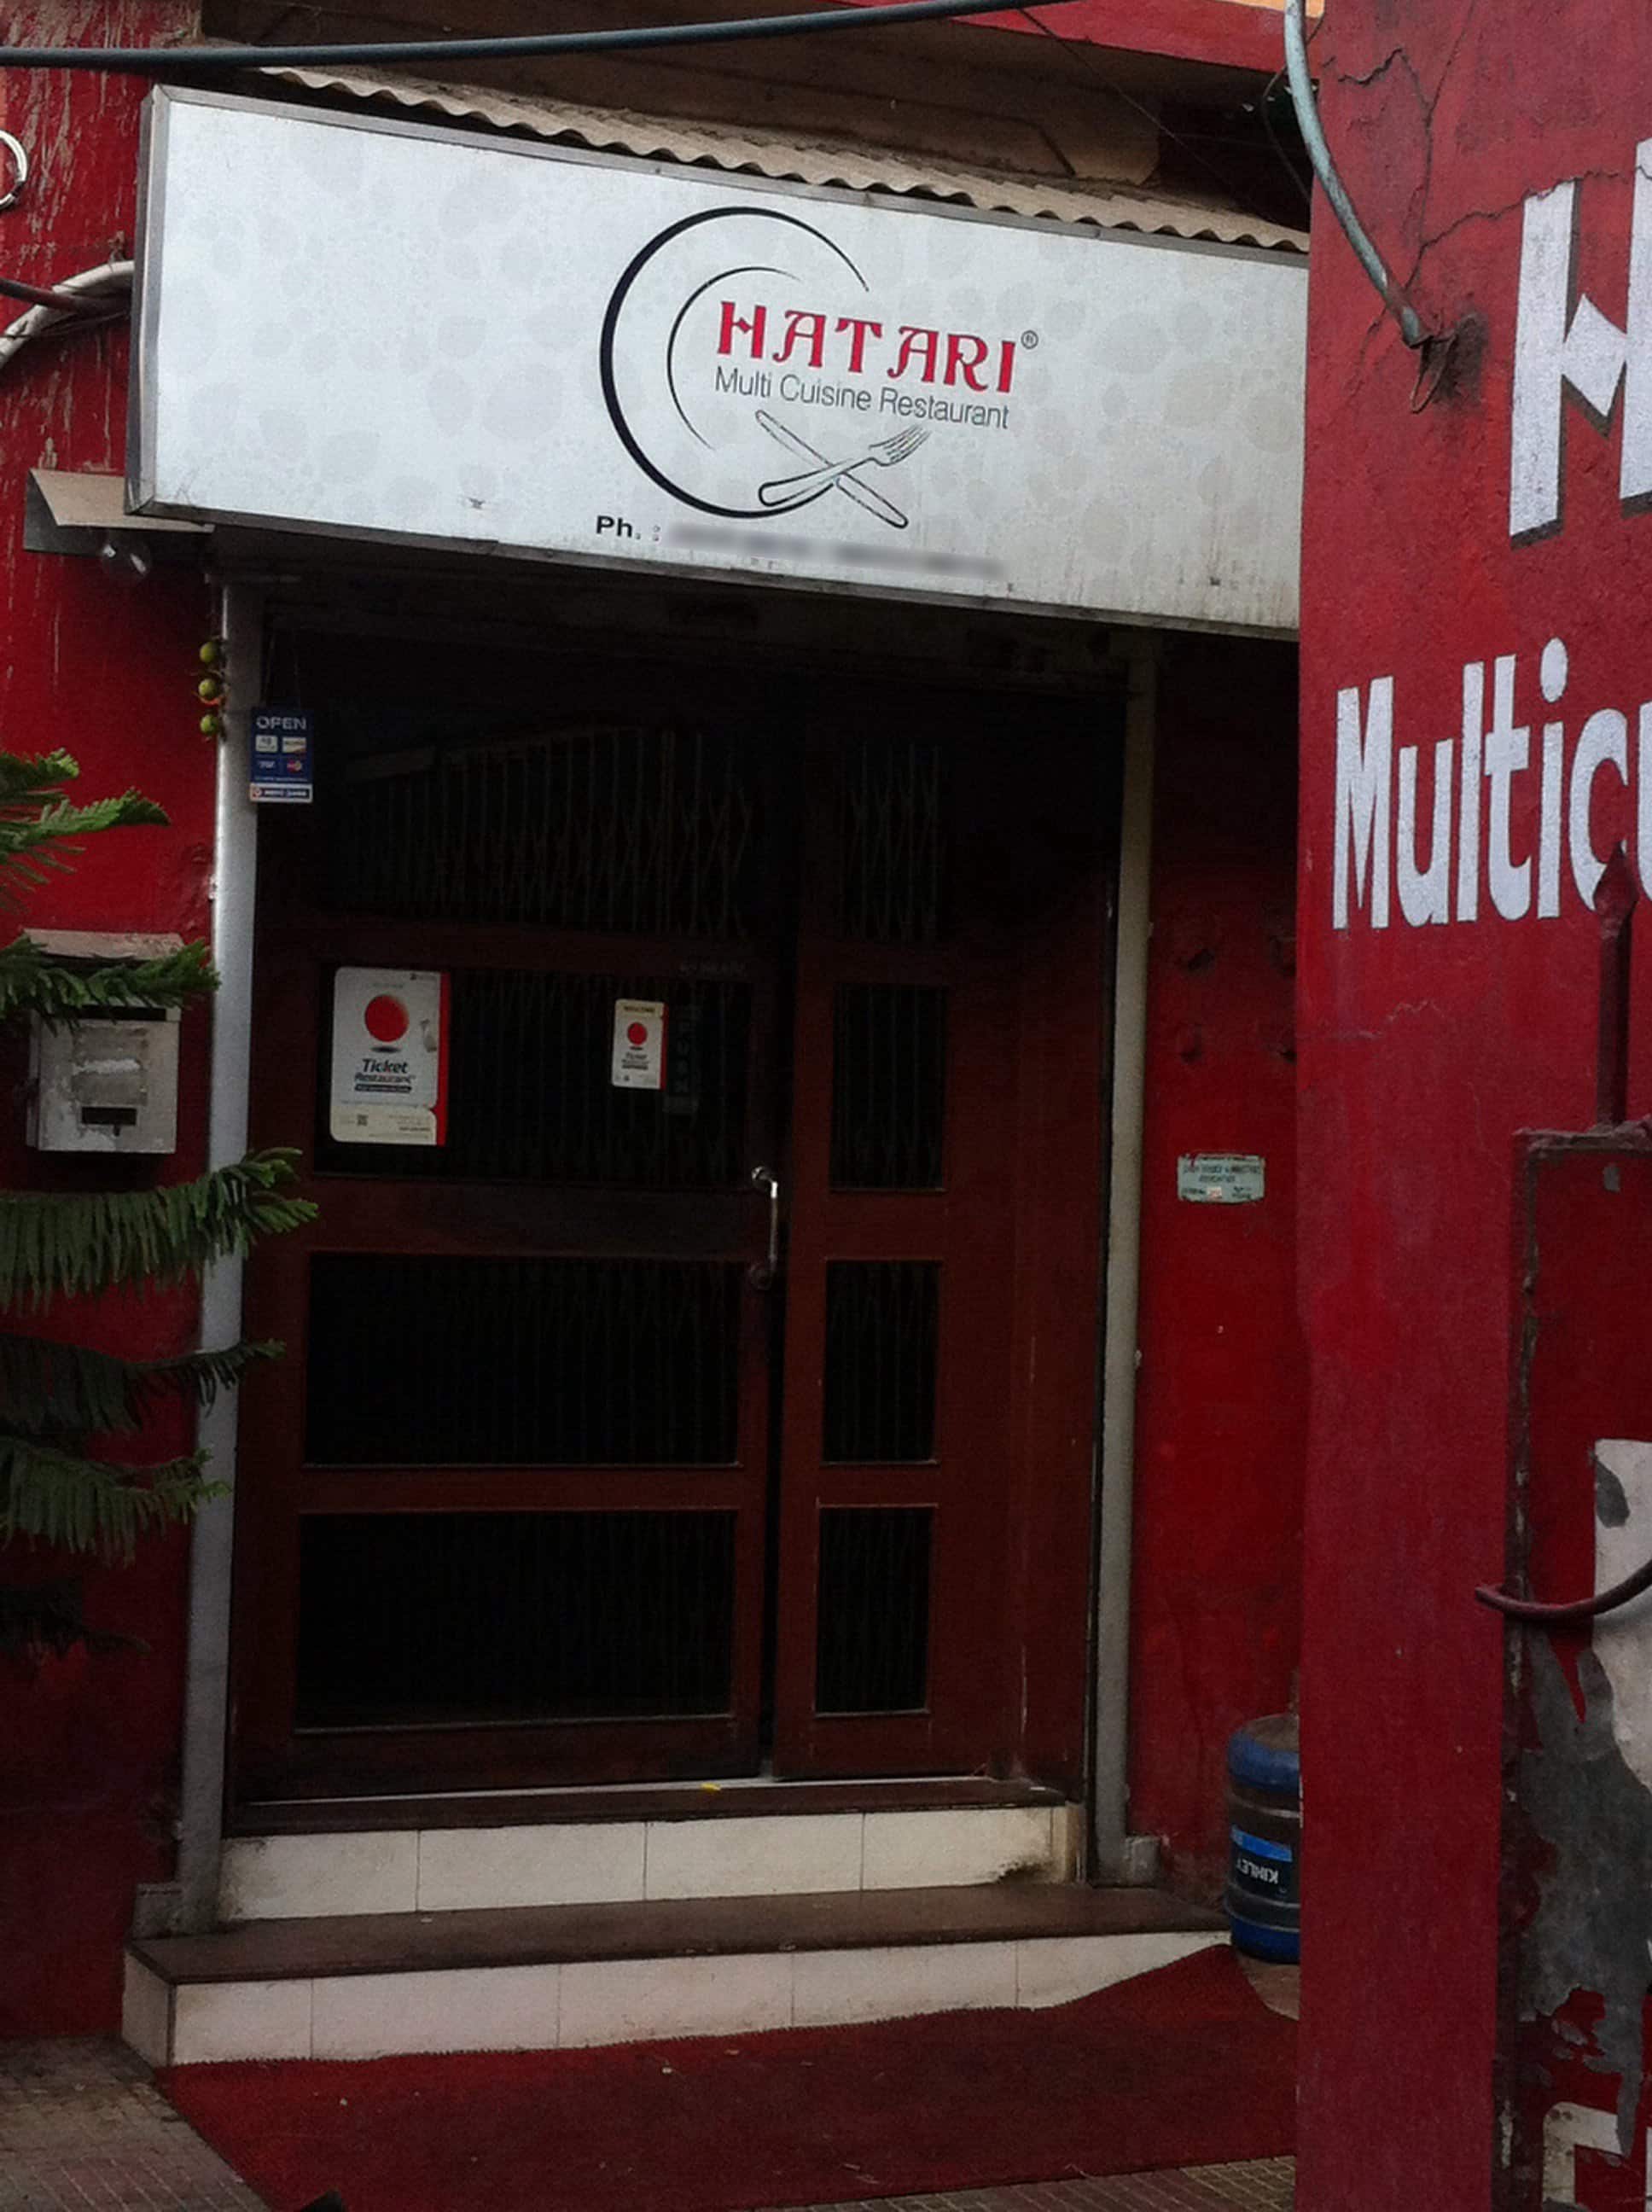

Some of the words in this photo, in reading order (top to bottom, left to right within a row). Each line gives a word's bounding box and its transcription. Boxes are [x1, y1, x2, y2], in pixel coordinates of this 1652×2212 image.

[717, 300, 1016, 393] HATARI
[714, 365, 771, 399] Multi
[779, 374, 873, 411] Cuisine
[879, 387, 1010, 430] Restaurant
[256, 716, 307, 730] OPEN
[362, 1058, 409, 1074] Ticket
